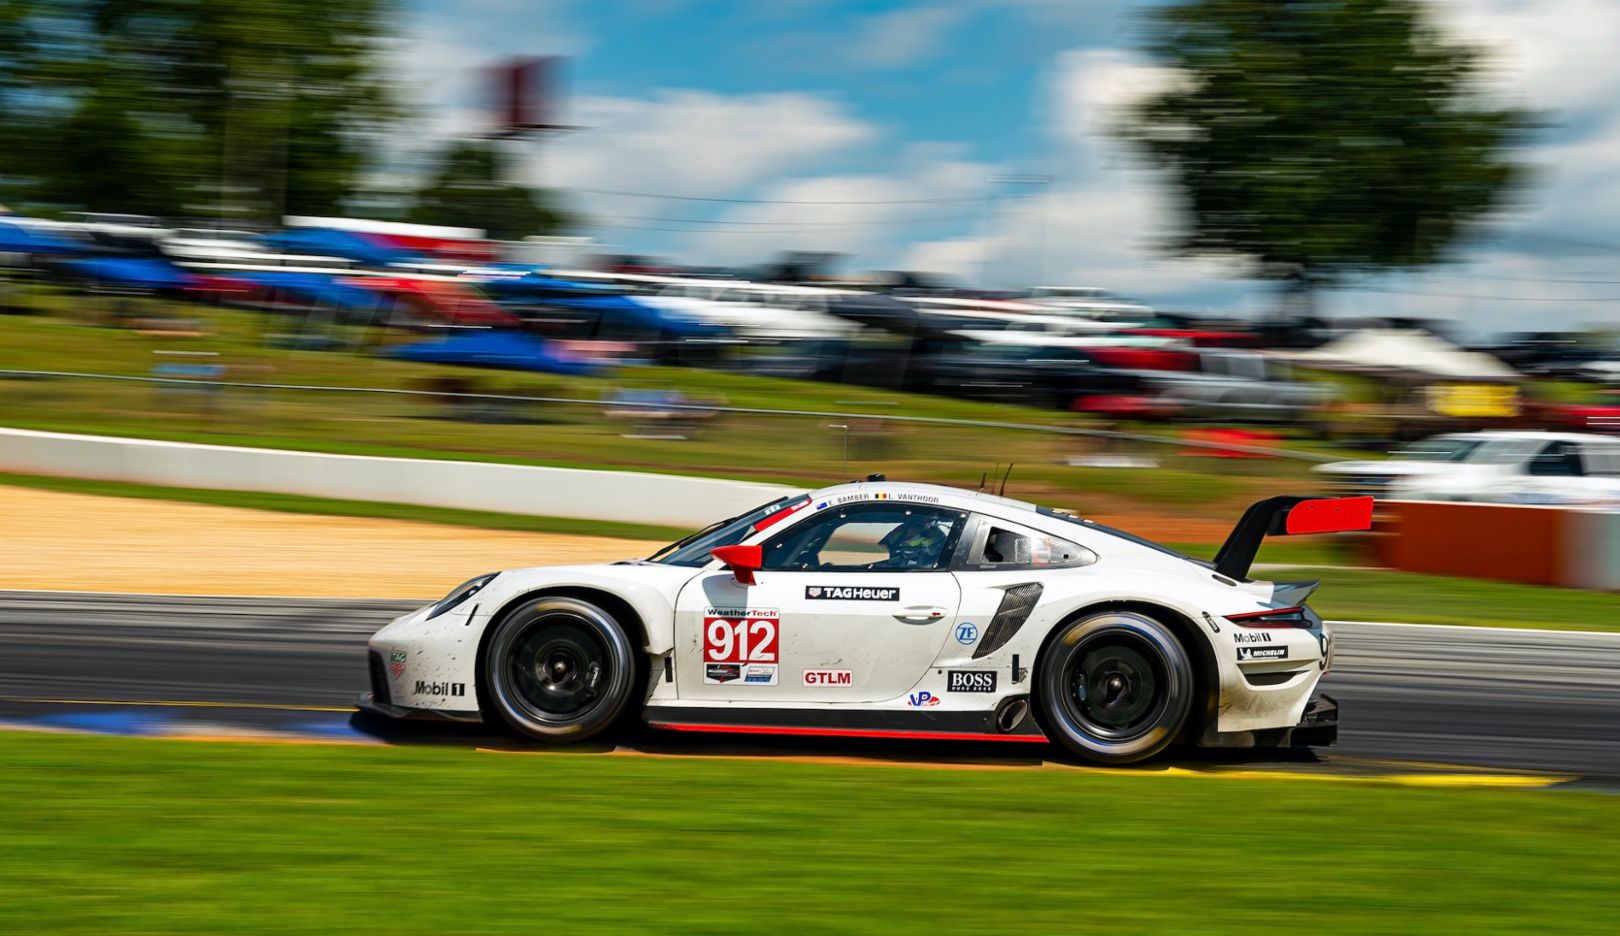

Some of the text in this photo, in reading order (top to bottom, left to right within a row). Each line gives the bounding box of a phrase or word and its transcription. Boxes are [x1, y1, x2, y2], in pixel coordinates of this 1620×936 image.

[708, 609, 777, 617] WeatherTech
[707, 619, 776, 661] 912
[957, 626, 977, 641] ZF
[1234, 632, 1262, 643] Mobil
[1253, 649, 1285, 657] MICHELIN
[805, 672, 851, 685] GTLM
[952, 672, 993, 687] BOSS
[413, 681, 449, 696] Mobil
[910, 691, 931, 706] VP
